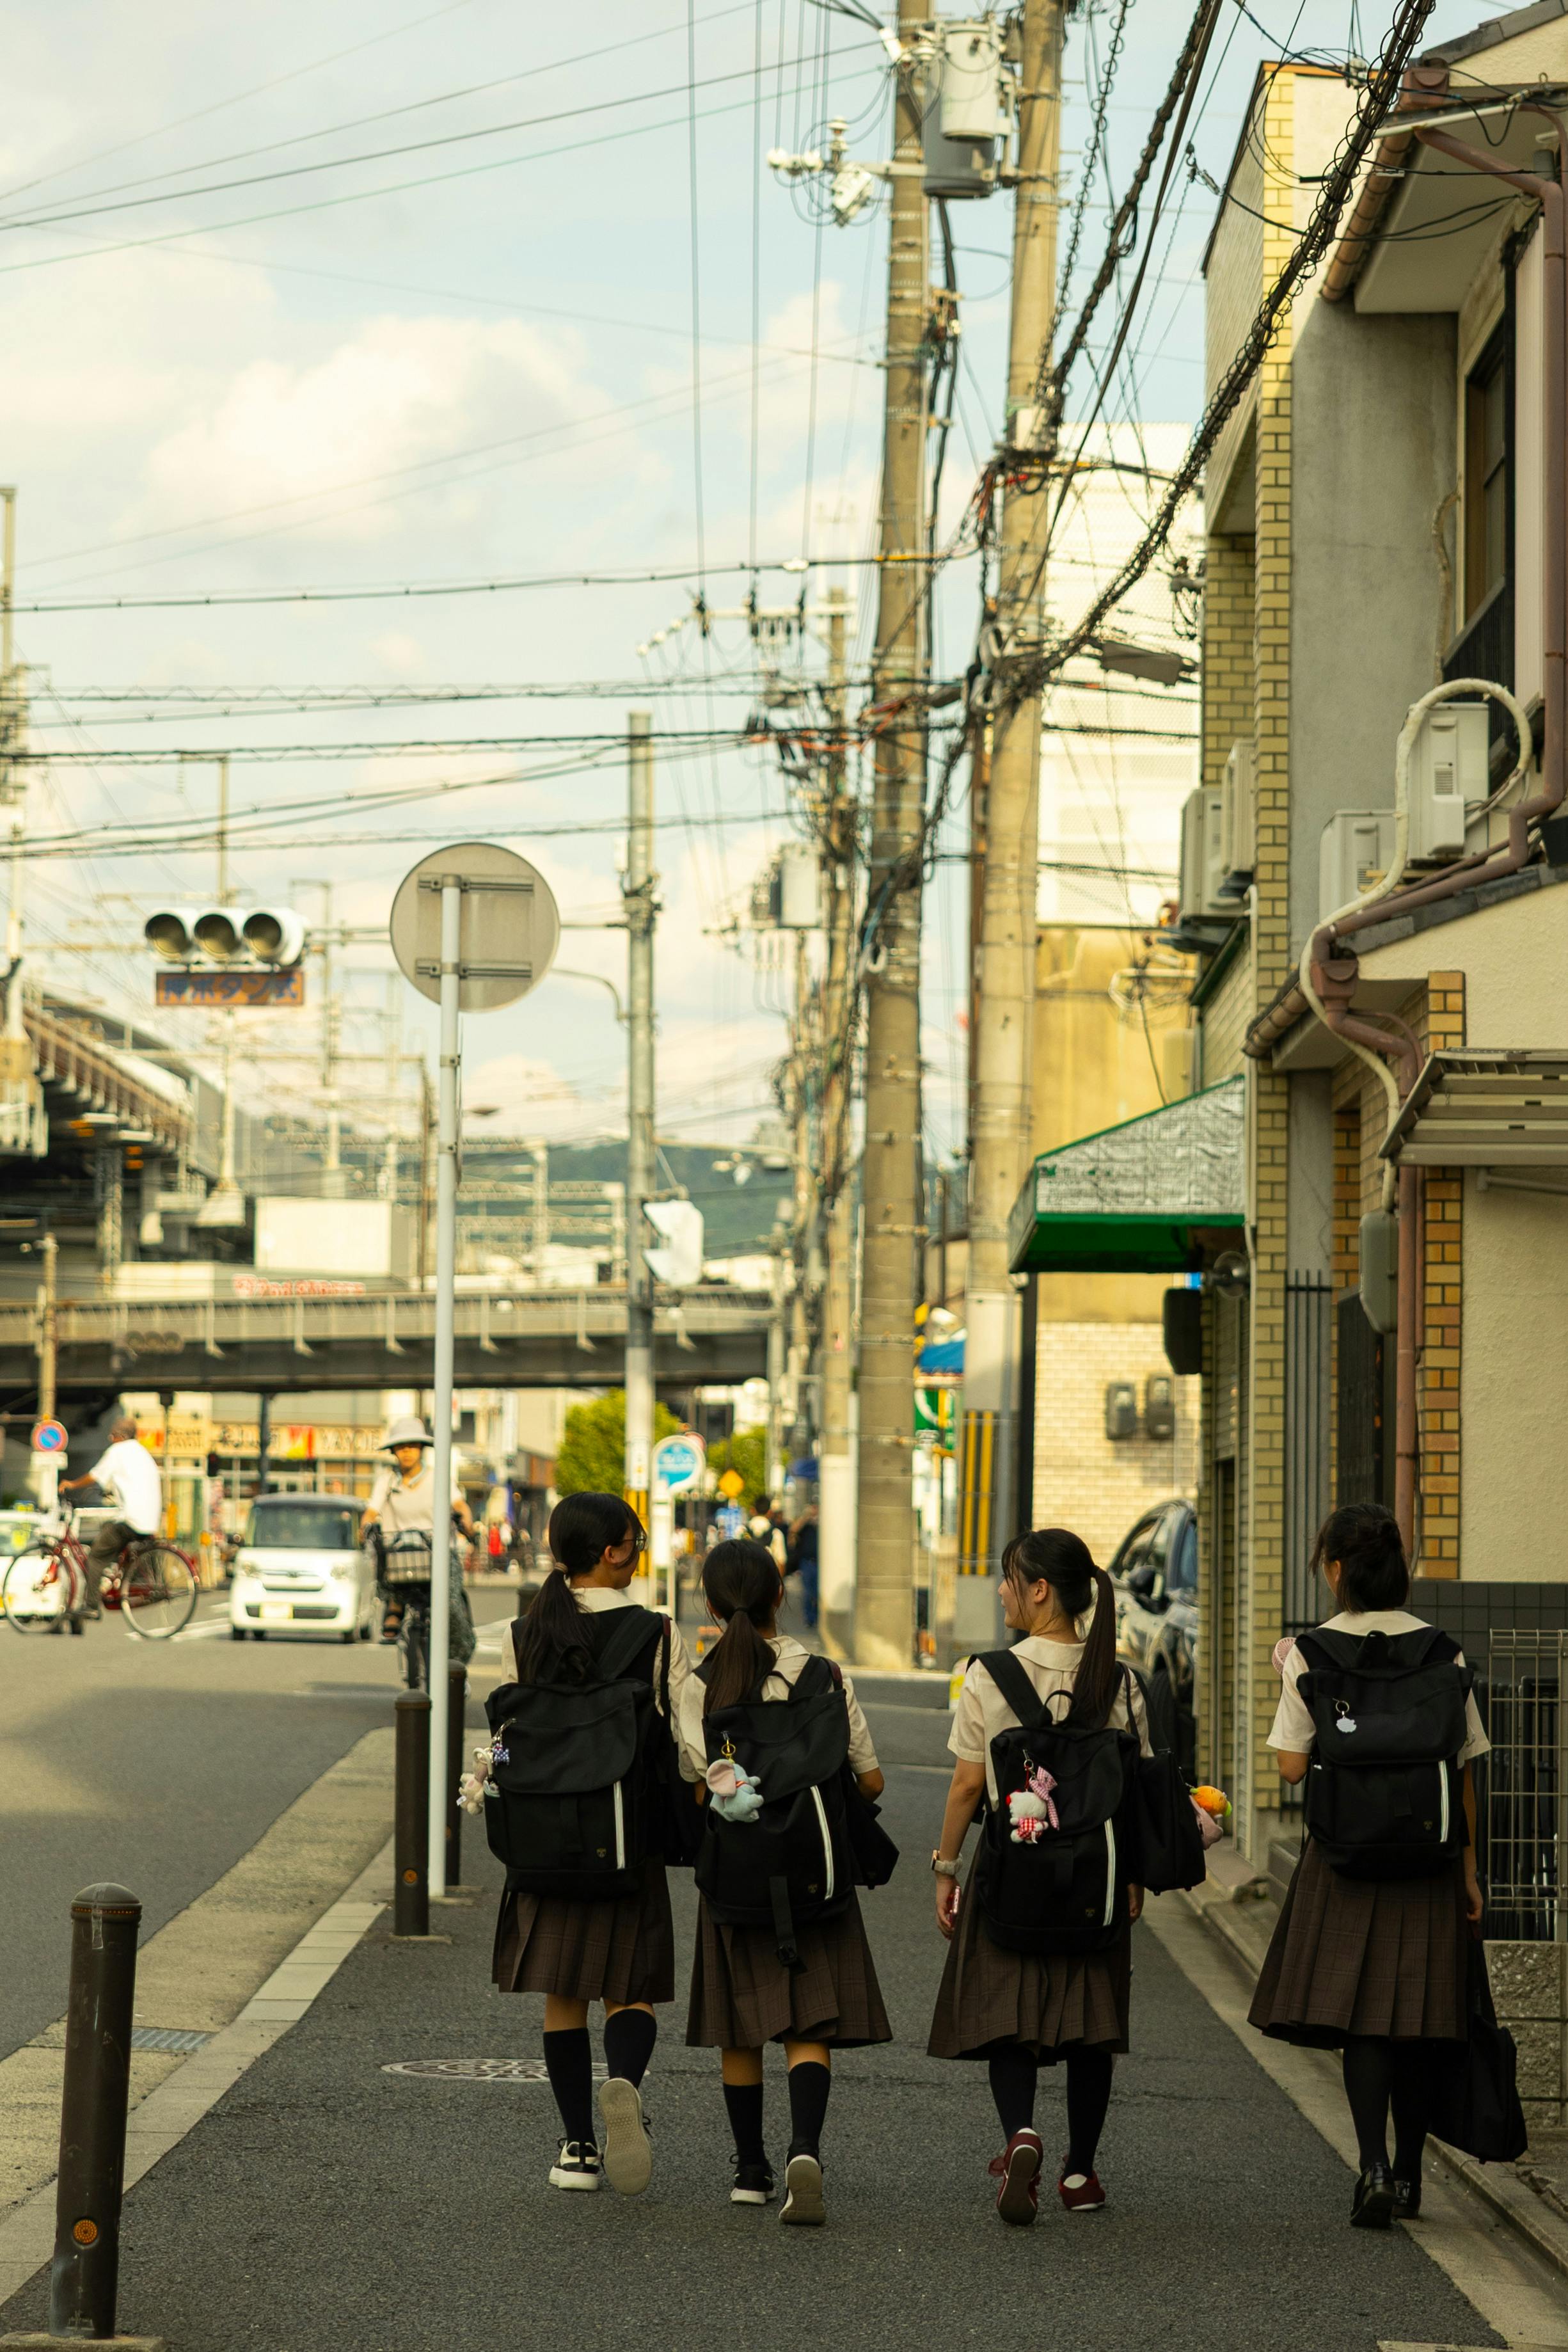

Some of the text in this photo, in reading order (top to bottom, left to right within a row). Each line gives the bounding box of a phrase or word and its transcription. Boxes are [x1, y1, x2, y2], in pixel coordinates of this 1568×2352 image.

[164, 976, 297, 999] 押ボタン式
